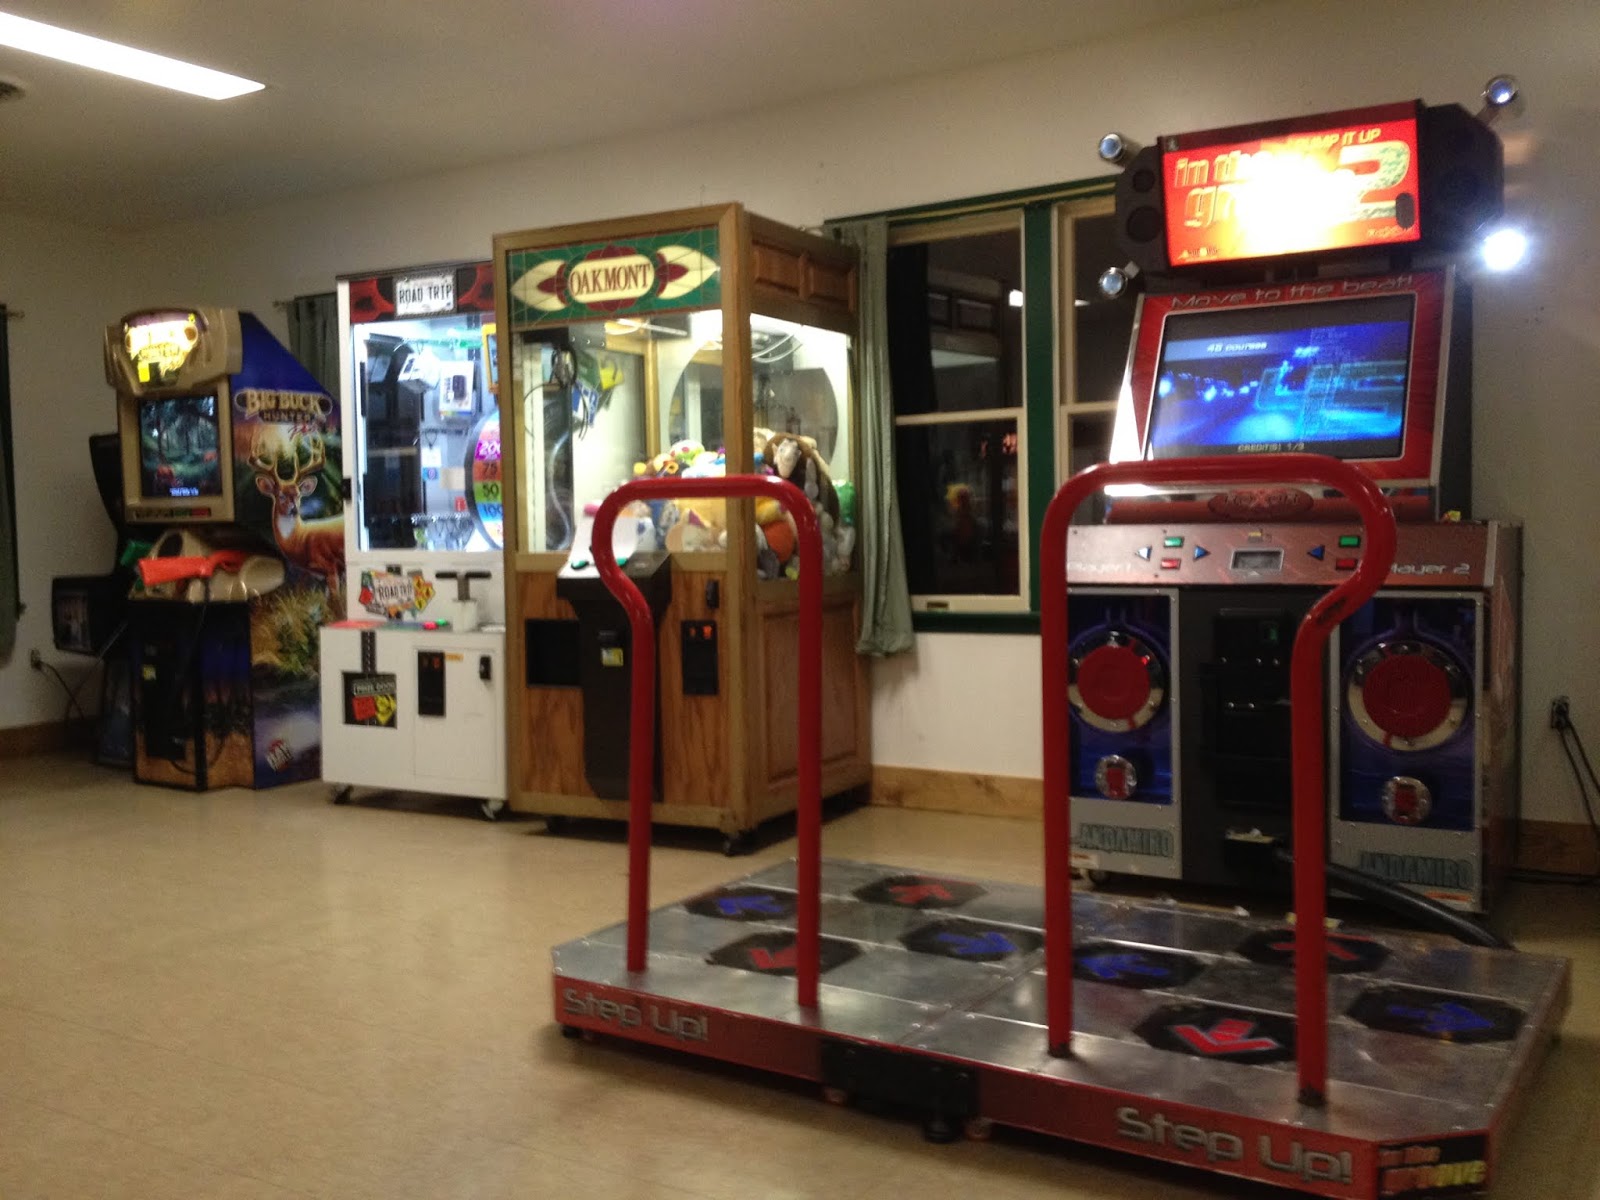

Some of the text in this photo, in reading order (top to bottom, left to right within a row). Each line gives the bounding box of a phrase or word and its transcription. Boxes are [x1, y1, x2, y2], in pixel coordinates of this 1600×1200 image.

[1342, 131, 1355, 146] IT
[1359, 128, 1381, 144] UP
[570, 262, 651, 297] OAKMONT
[399, 284, 452, 305] ROAD TRIP
[1172, 292, 1246, 309] Move
[1255, 287, 1281, 301] to
[1290, 283, 1334, 297] the
[243, 388, 326, 421] BIG BUCK
[480, 440, 500, 454] 20
[483, 483, 499, 498] 50
[1390, 562, 1470, 577] layer 2
[378, 585, 399, 601] ROAD
[563, 987, 709, 1042] Step Up!
[1116, 1106, 1354, 1185] Step Up!
